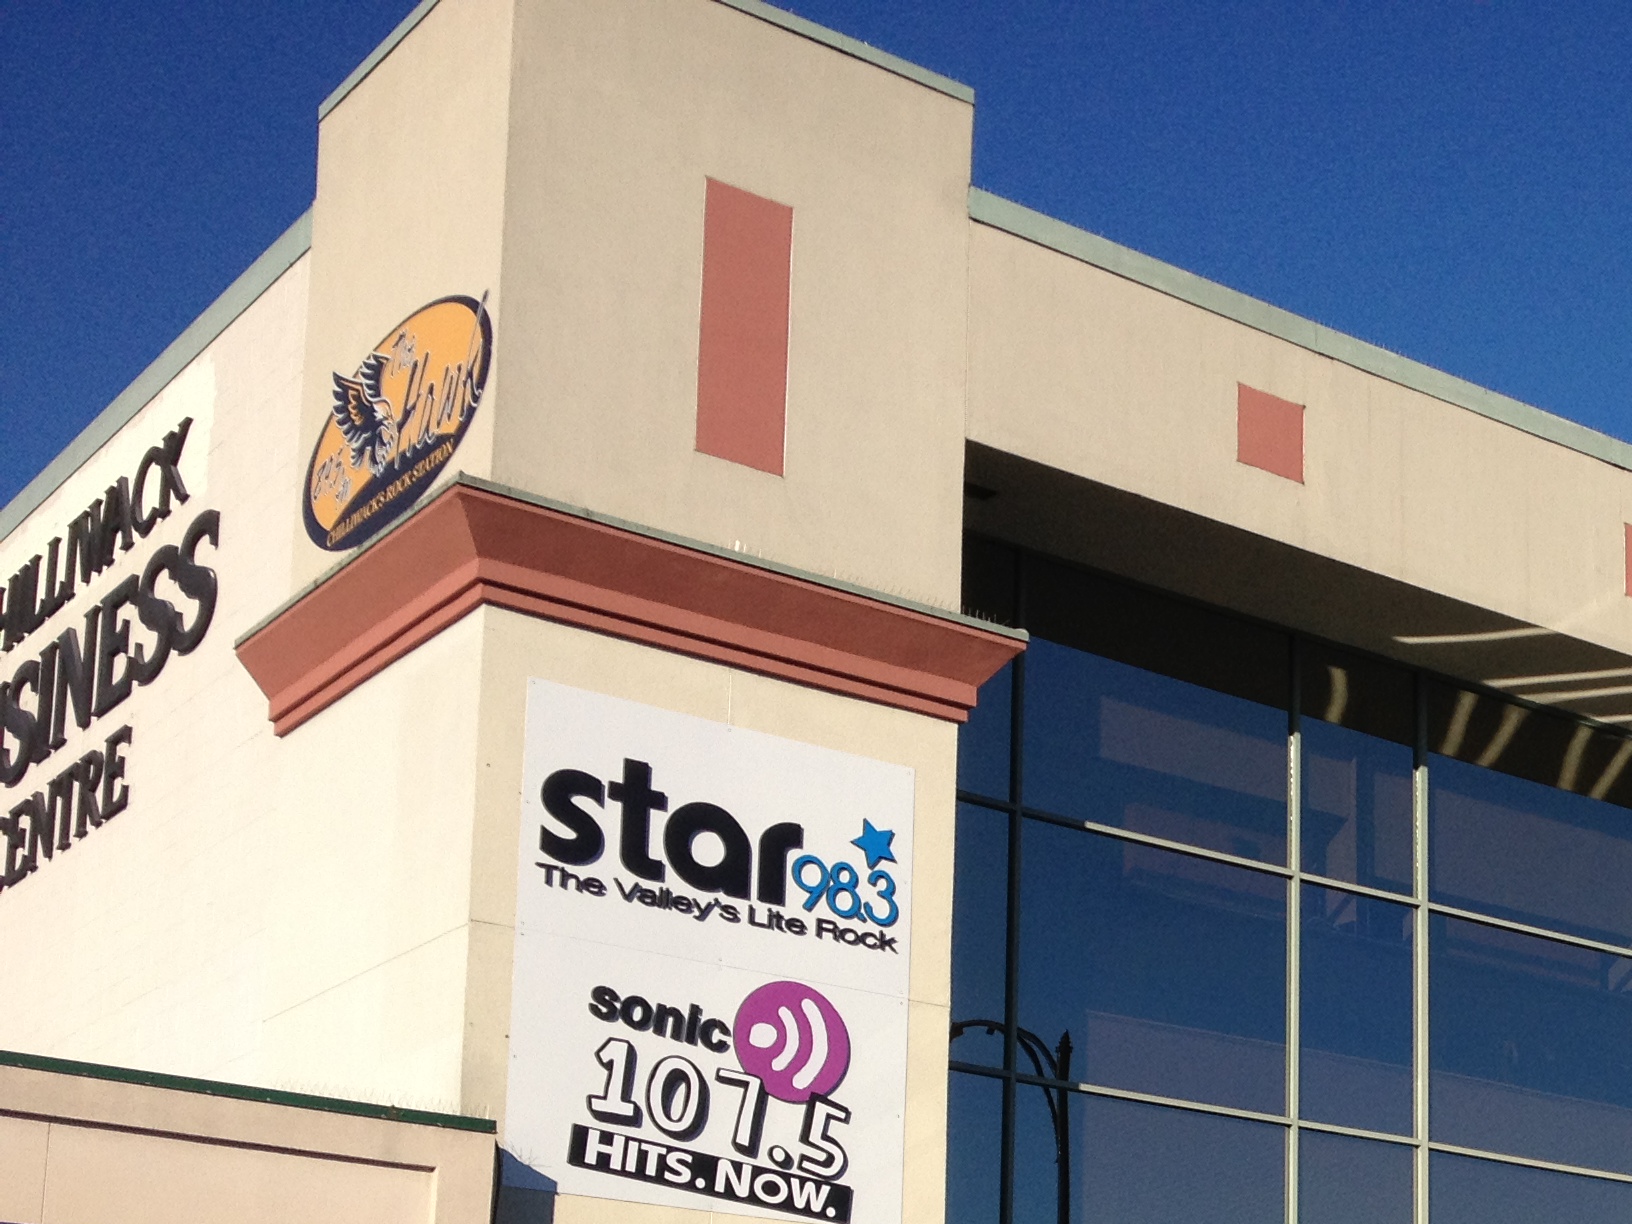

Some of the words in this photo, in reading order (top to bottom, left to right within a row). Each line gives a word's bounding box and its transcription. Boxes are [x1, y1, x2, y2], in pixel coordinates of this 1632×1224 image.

[385, 470, 418, 501] ROCK
[412, 438, 455, 481] STATION
[539, 757, 804, 906] star
[791, 855, 900, 927] 98.3
[535, 861, 607, 897] The
[613, 877, 741, 922] Valley's
[748, 904, 808, 936] Lite
[815, 917, 899, 955] Rock
[588, 985, 732, 1053] sonic
[586, 1036, 852, 1181] 107.5
